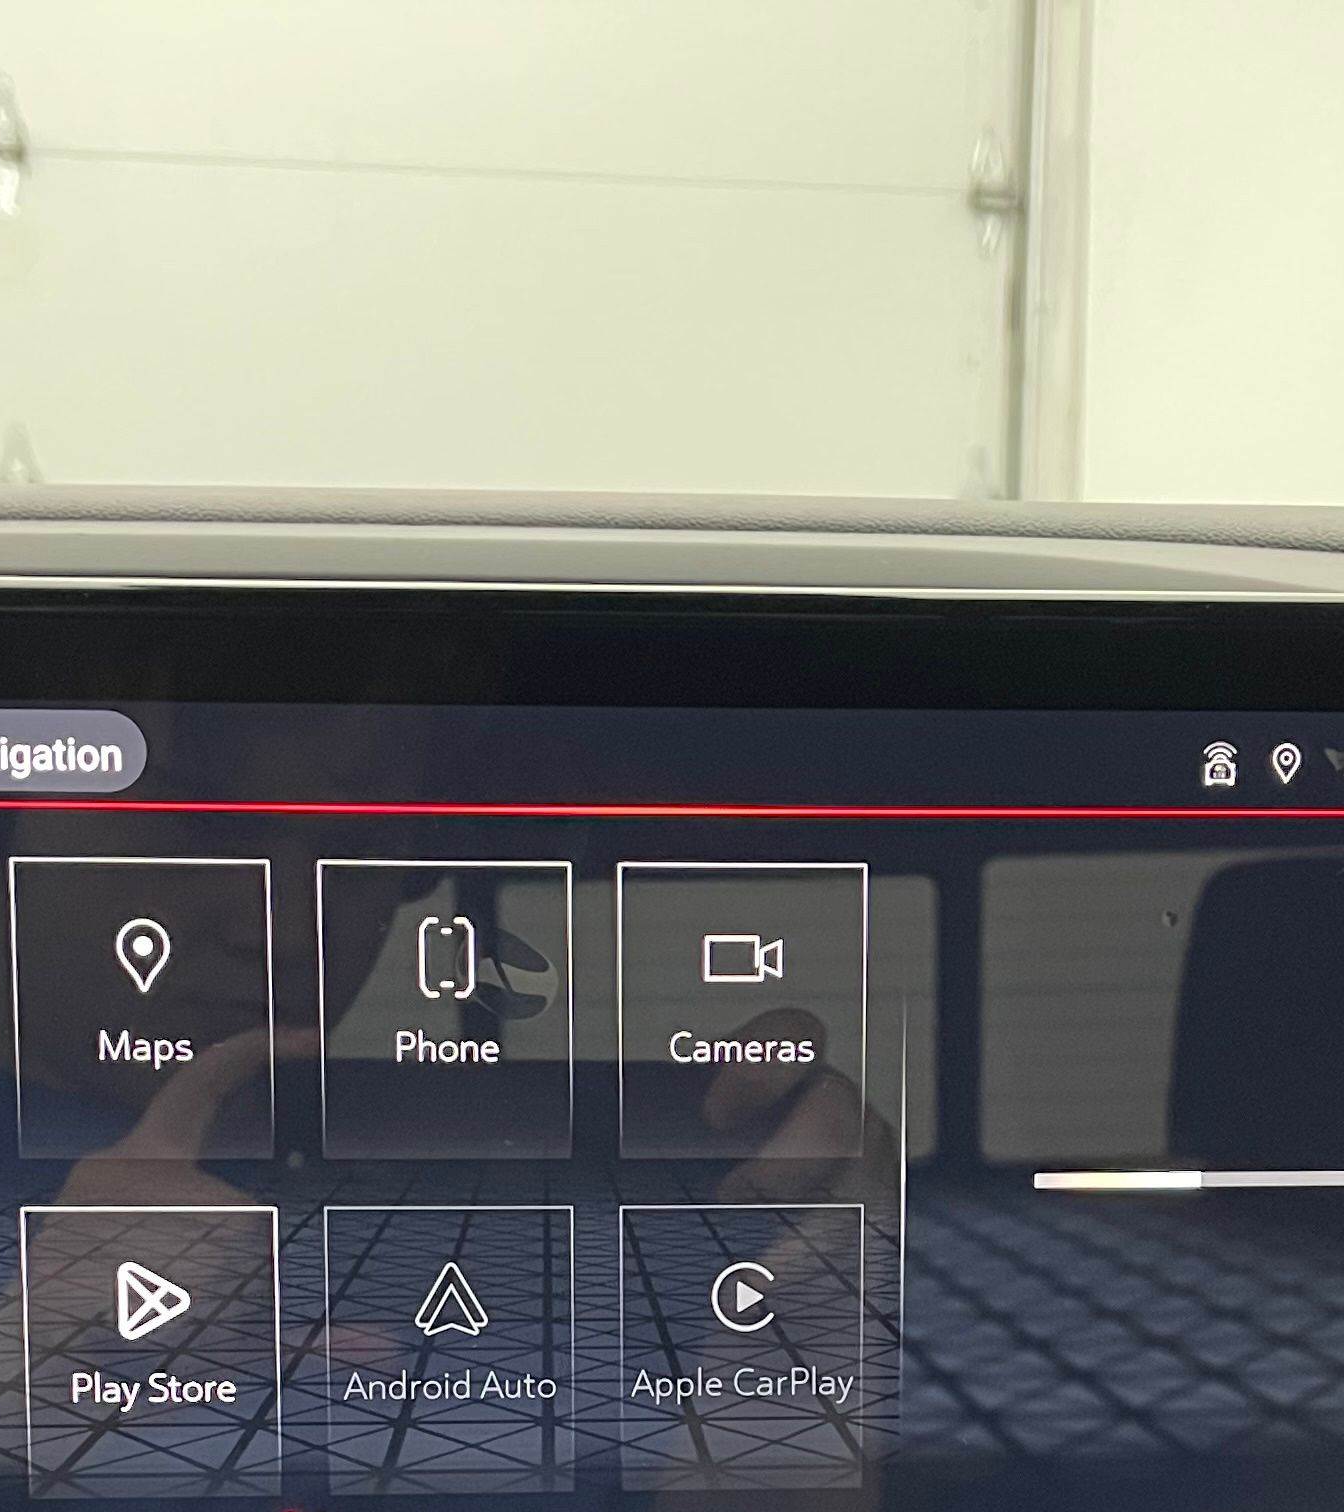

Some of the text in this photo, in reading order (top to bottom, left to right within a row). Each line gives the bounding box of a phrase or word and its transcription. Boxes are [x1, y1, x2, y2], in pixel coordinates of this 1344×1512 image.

[98, 1029, 194, 1071] Maps
[396, 1028, 500, 1063] Phone
[669, 1030, 815, 1063] Cameras
[72, 1370, 237, 1413] Play Store
[343, 1368, 557, 1401] Android Auto
[631, 1365, 854, 1406] Apple CarPlay
